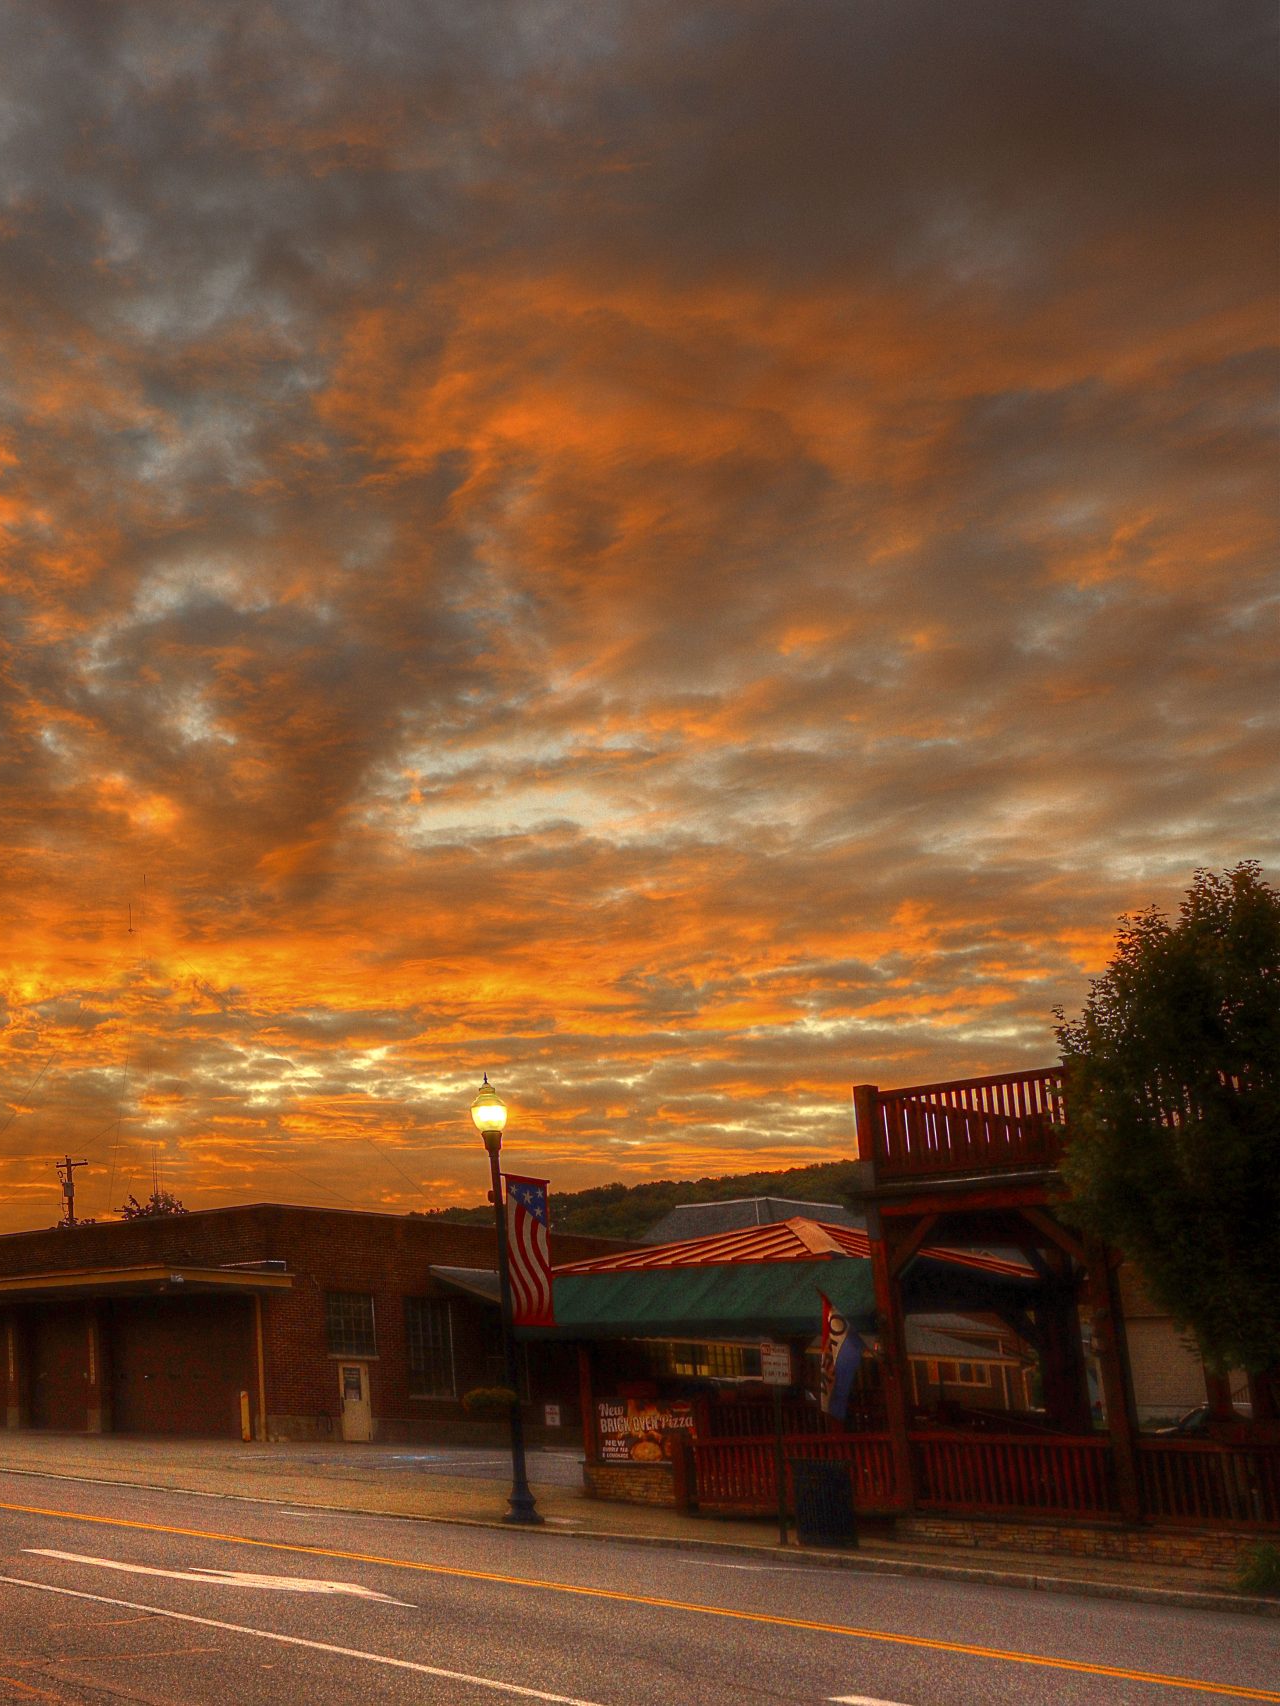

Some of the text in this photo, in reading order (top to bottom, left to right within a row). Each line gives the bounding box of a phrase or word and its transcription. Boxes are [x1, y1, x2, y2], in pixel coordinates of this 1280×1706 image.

[598, 1403, 624, 1417] New
[600, 1413, 694, 1433] BRICK OVEN Pizza
